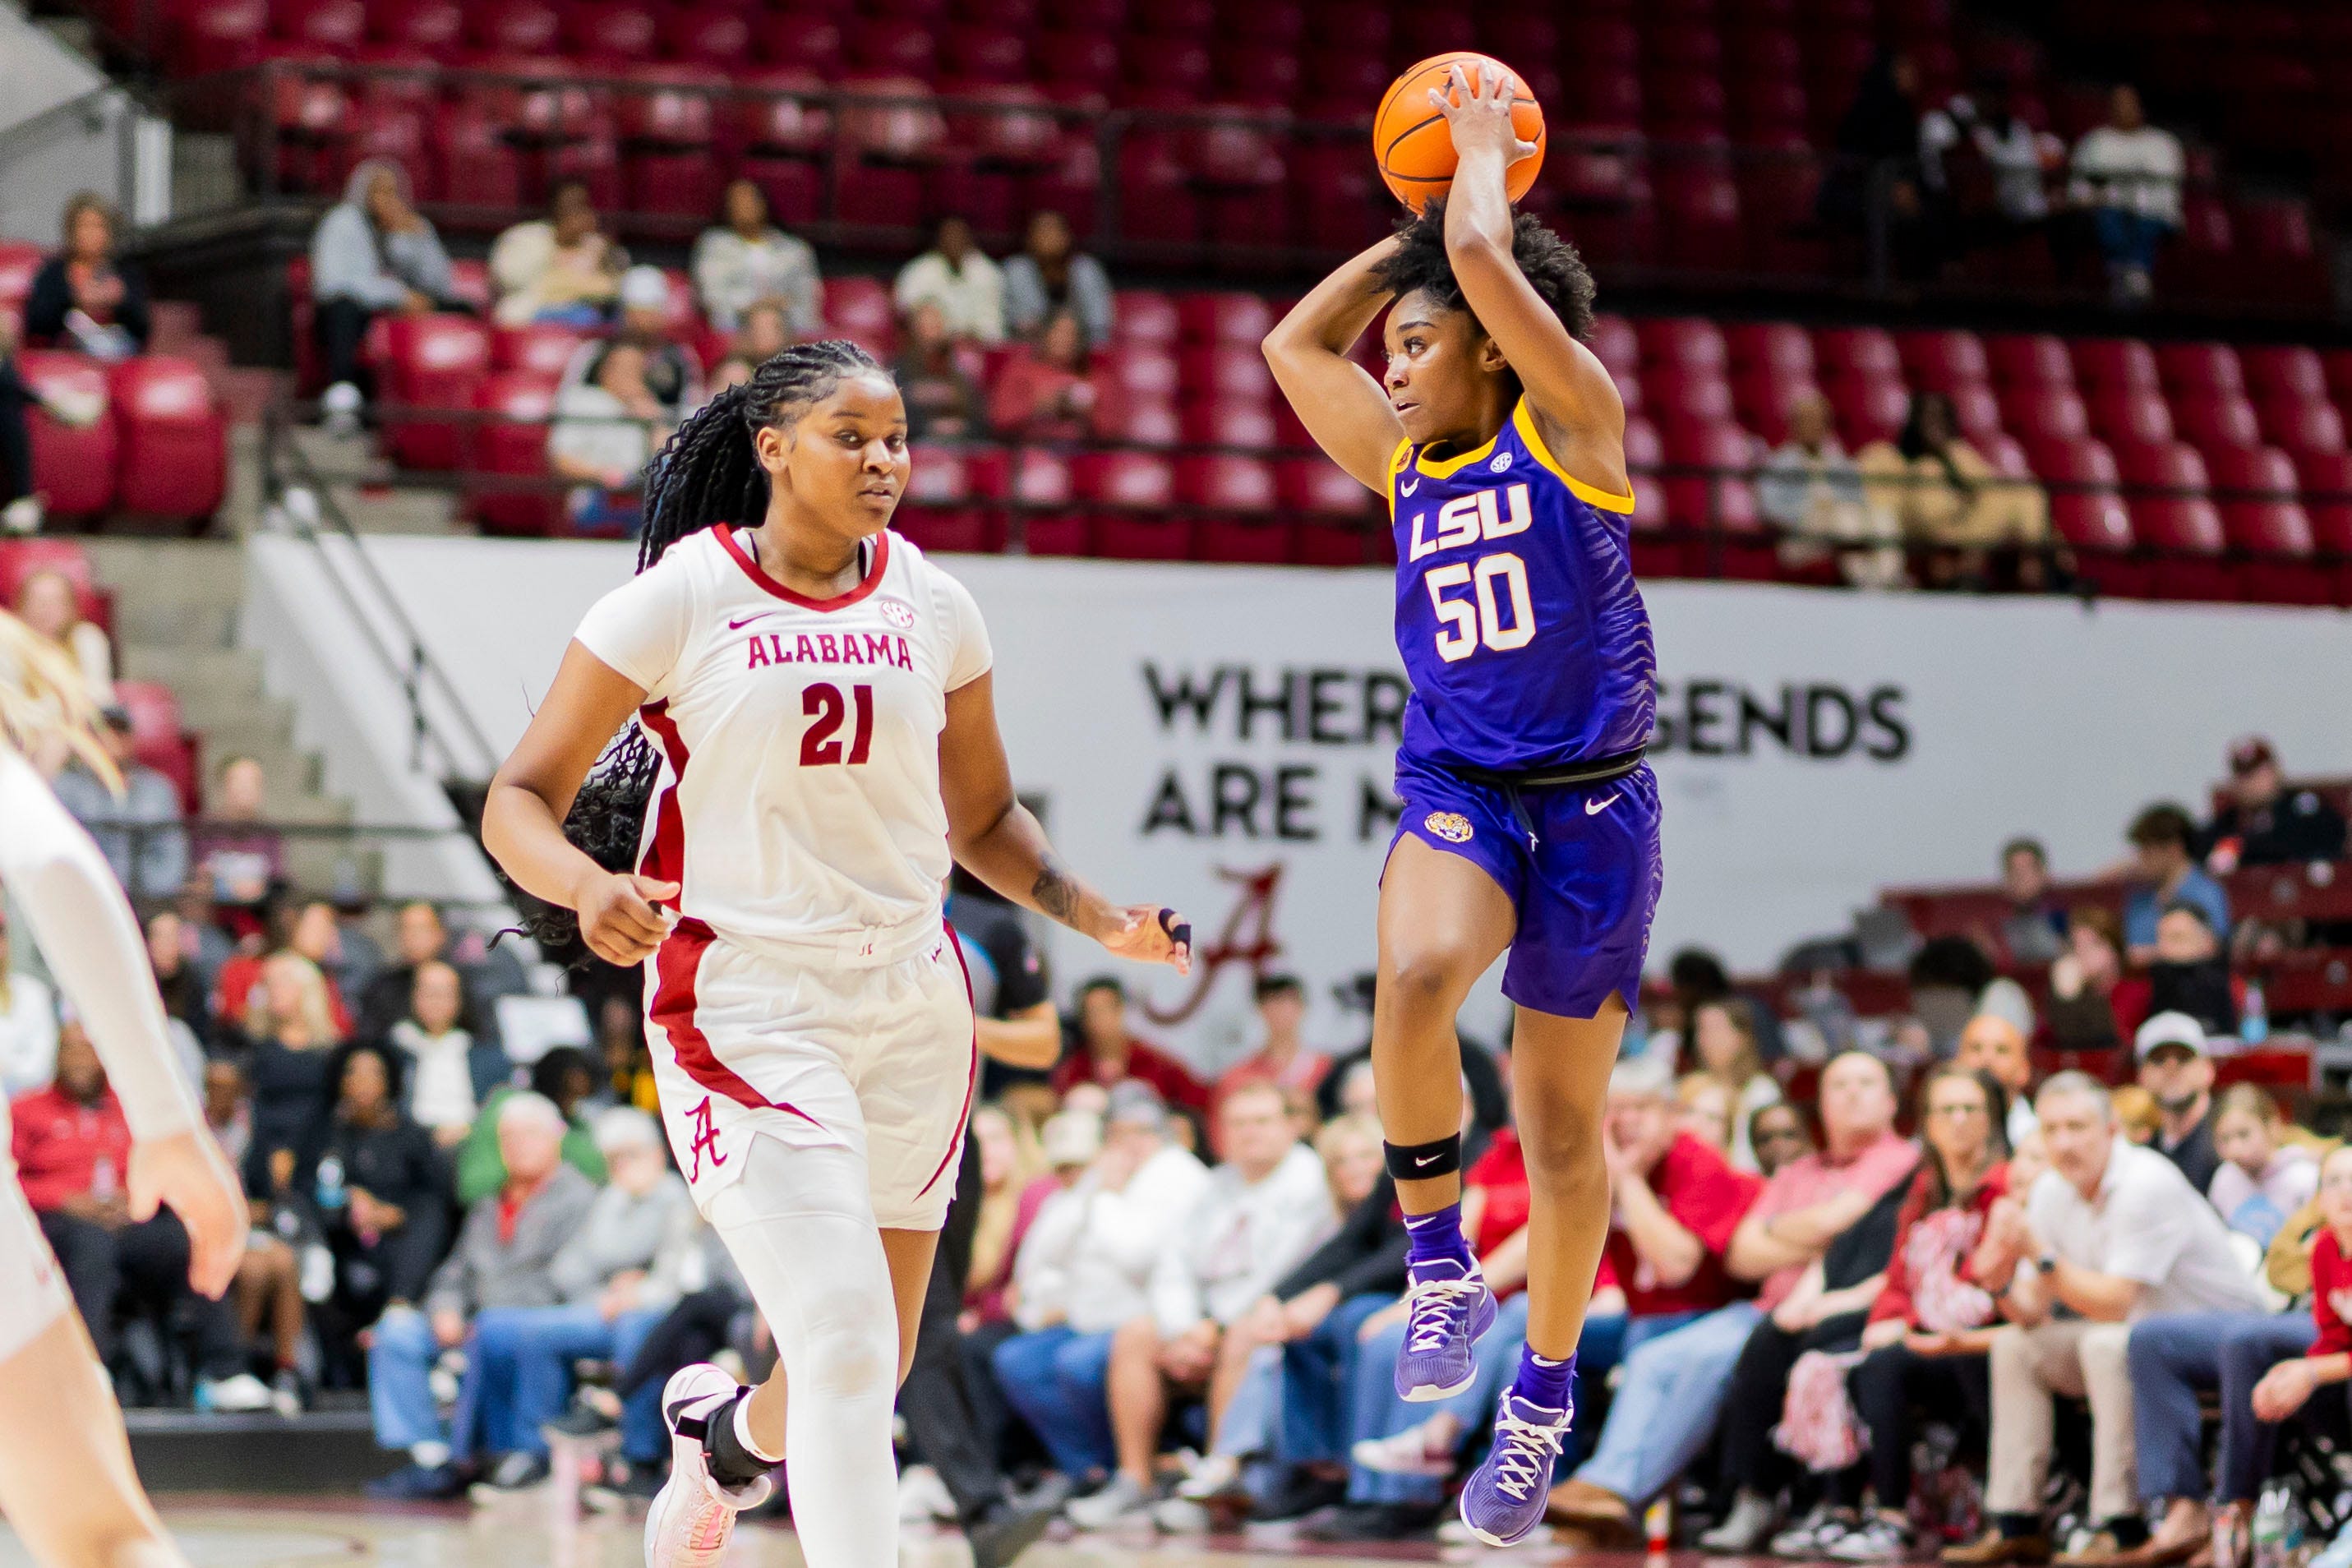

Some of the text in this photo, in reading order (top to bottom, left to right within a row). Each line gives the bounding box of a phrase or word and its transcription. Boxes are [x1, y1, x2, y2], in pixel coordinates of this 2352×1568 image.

[1409, 484, 1532, 562] LSU
[1425, 552, 1536, 662] 50
[748, 634, 913, 672] ALABAMA
[800, 682, 873, 766] 21
[1142, 763, 1317, 839] ARE
[685, 1095, 727, 1184] A
